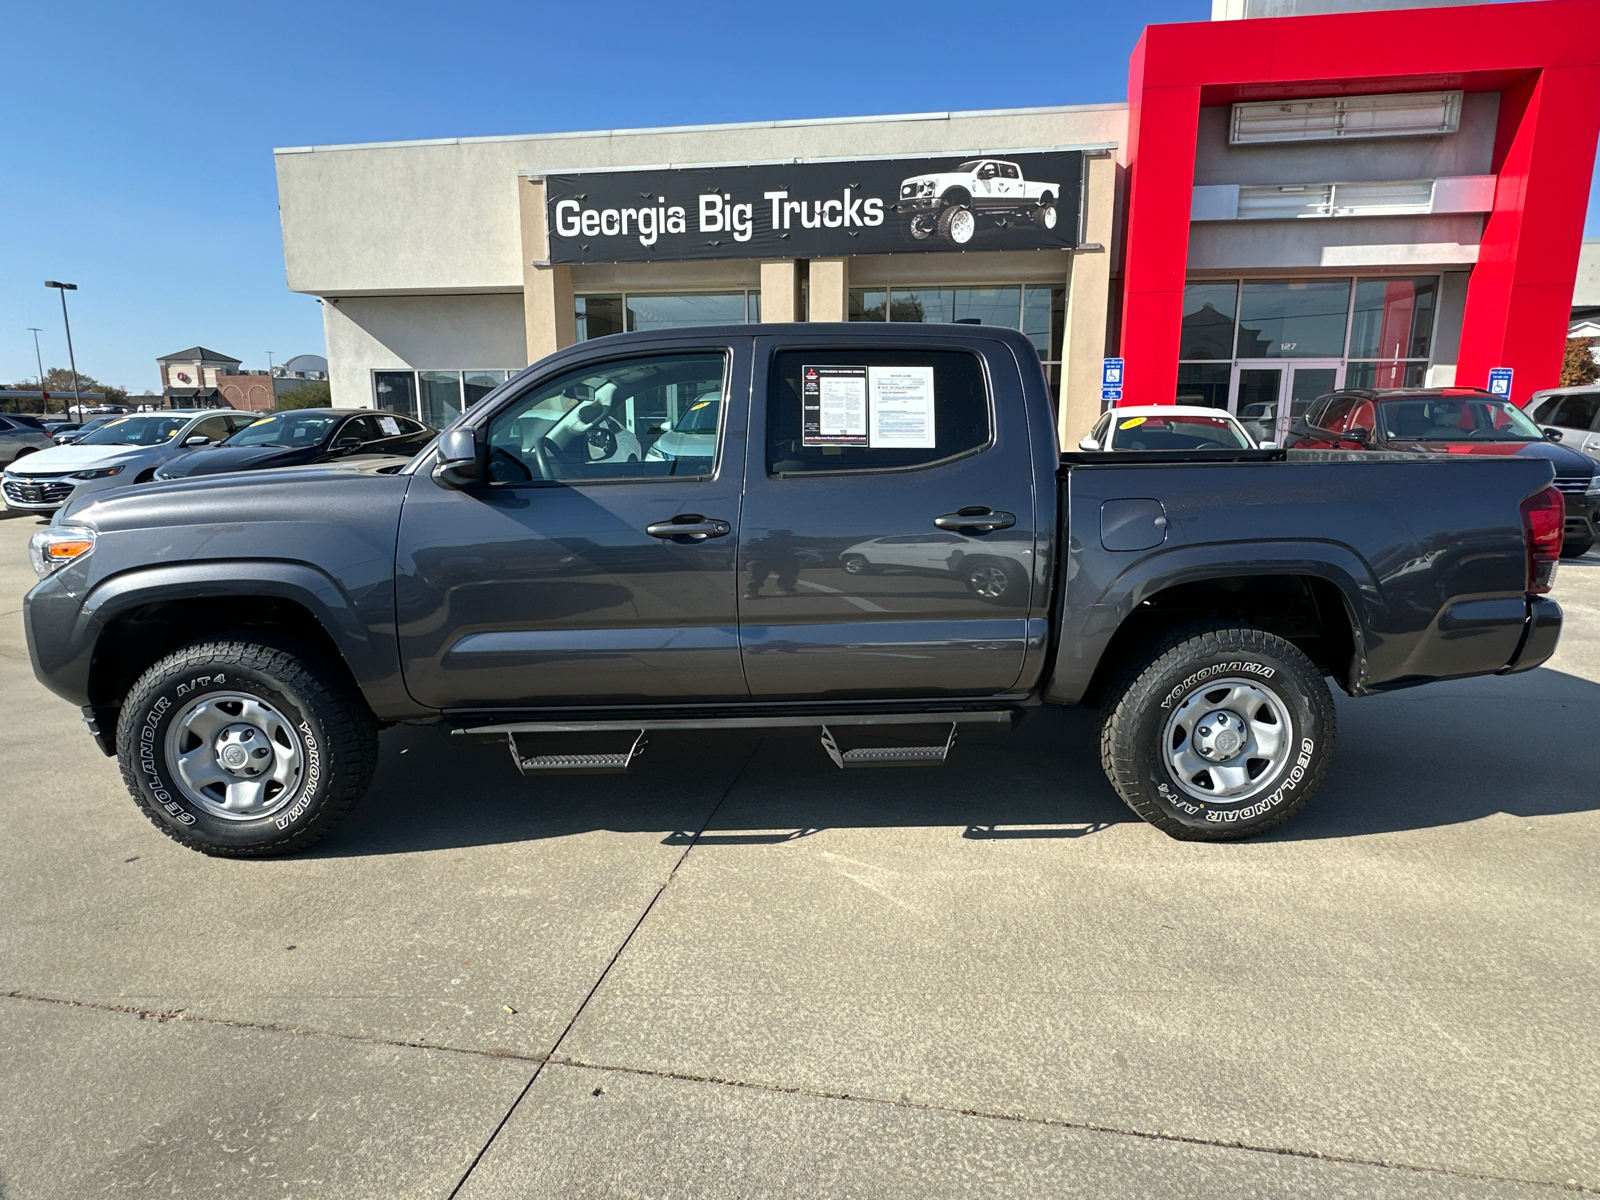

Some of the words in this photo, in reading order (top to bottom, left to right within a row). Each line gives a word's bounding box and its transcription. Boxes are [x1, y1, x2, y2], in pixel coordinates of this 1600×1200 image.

[556, 196, 686, 247] Georgia
[699, 193, 753, 242] Big
[763, 188, 885, 230] Trucks
[1280, 342, 1297, 350] 127
[1160, 661, 1276, 709] YOKOHAMA
[140, 696, 197, 825] GEOLANDAR
[275, 721, 320, 830] YOKOHAMA
[1205, 737, 1314, 822] GEOLANDAR
